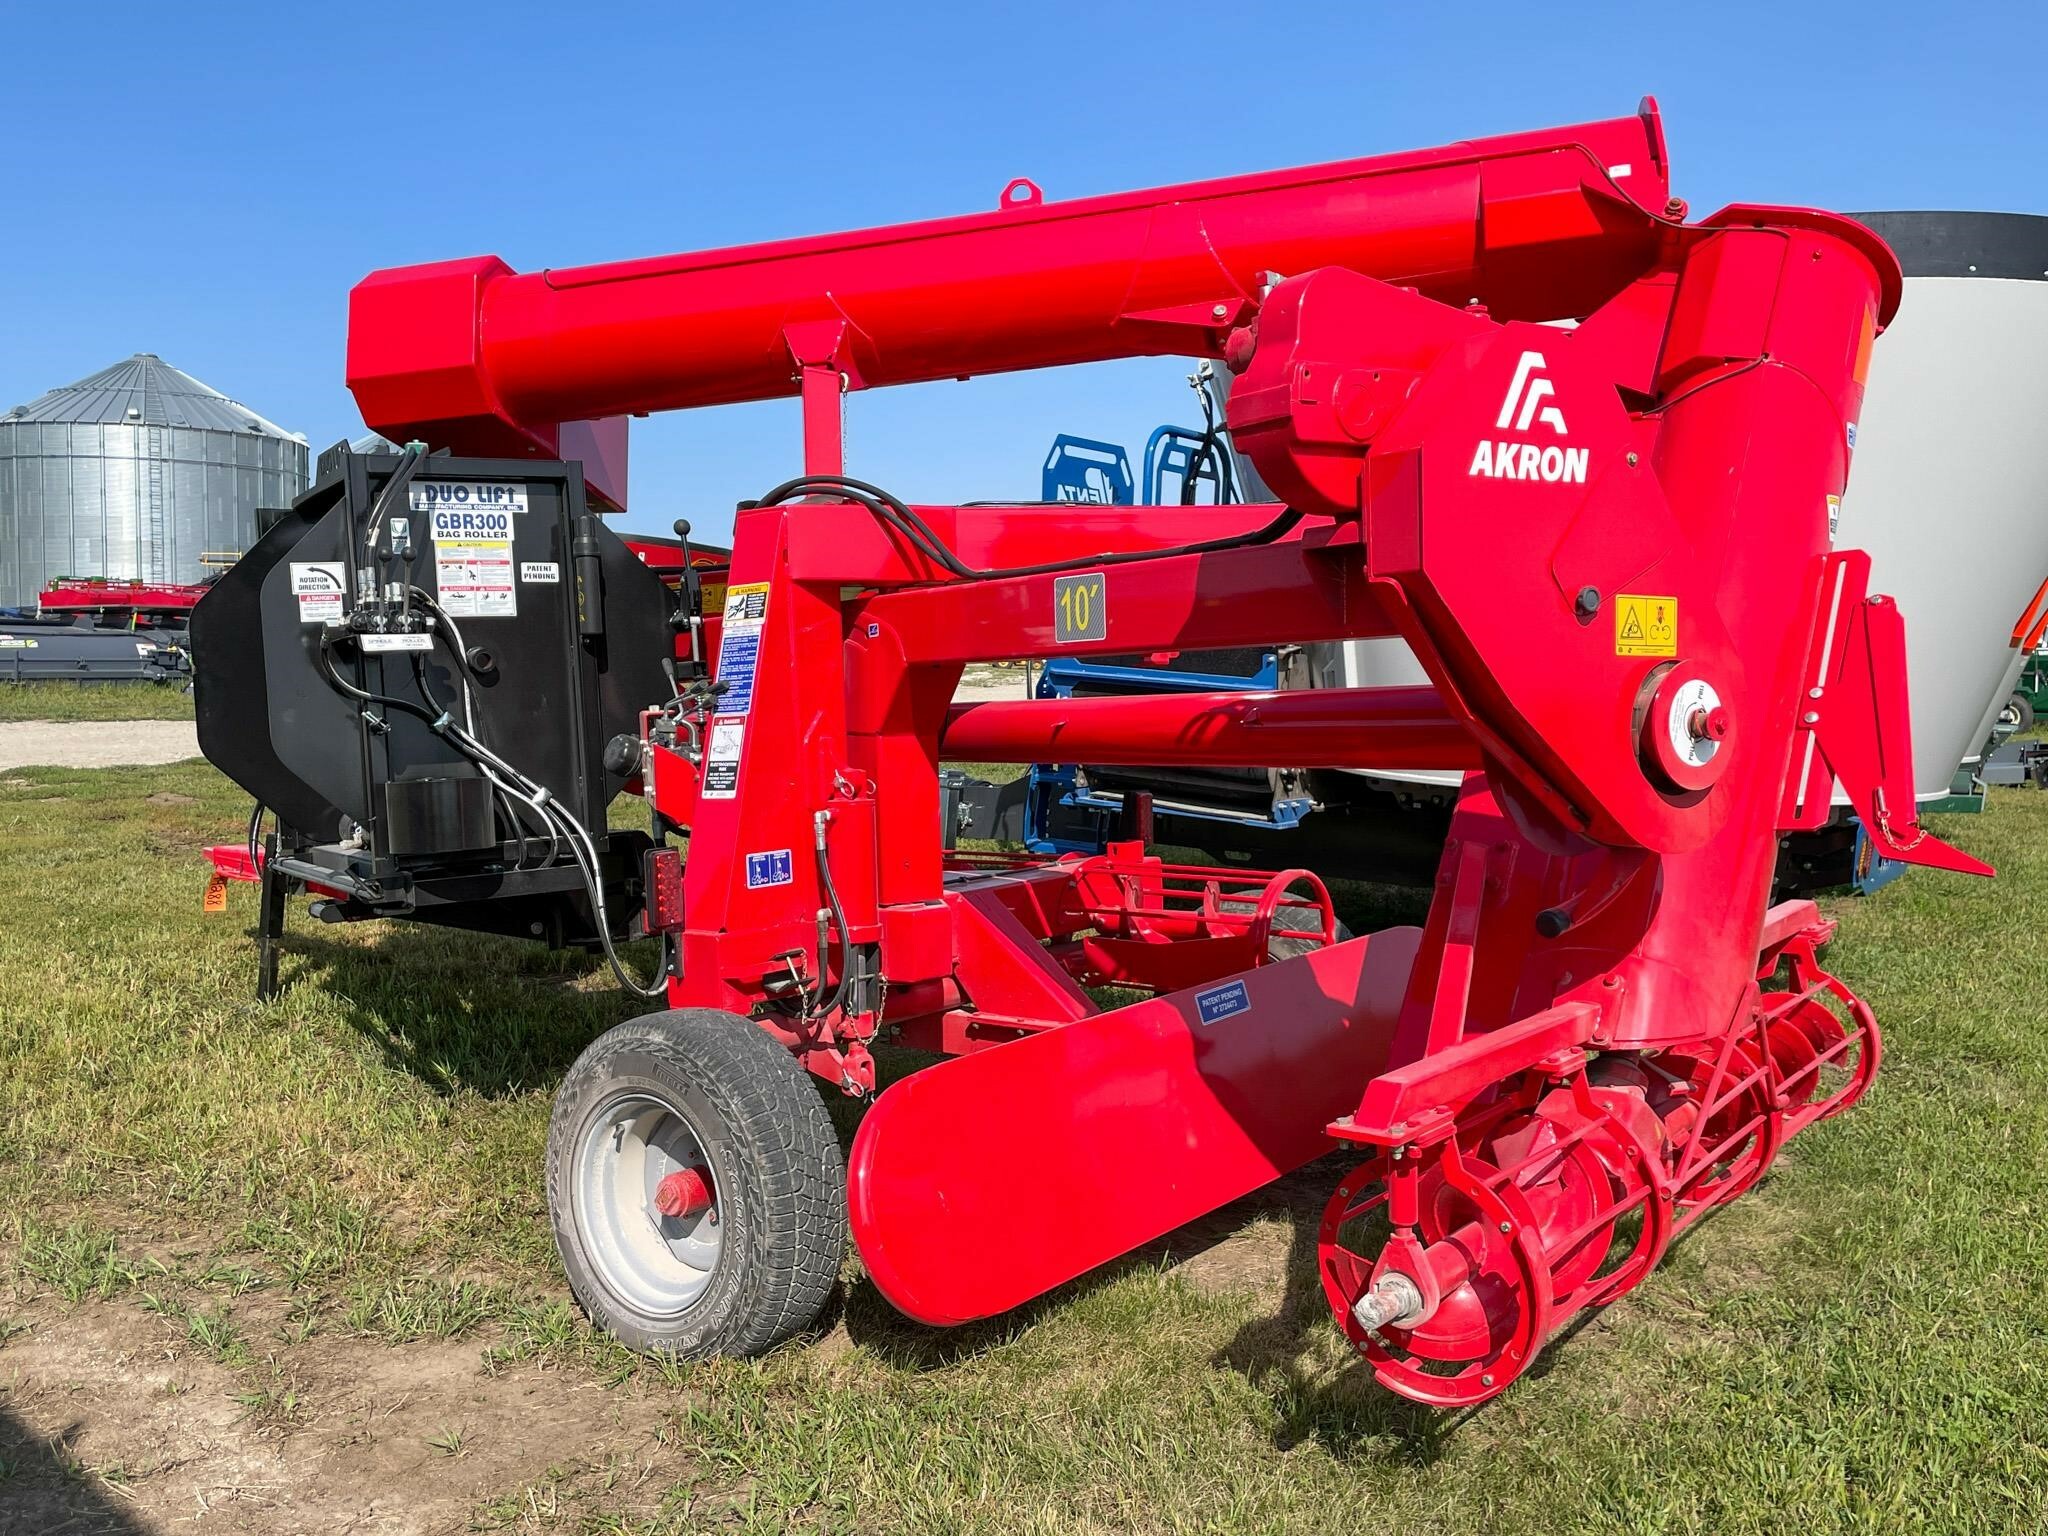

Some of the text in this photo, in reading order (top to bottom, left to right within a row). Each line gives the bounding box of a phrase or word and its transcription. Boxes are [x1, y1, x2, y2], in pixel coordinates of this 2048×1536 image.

[1468, 439, 1589, 484] AKRON
[425, 484, 470, 503] DUO
[435, 512, 508, 530] GBR300
[437, 530, 508, 539] BAG ROLLER
[1202, 988, 1242, 1007] PATENT PENDING
